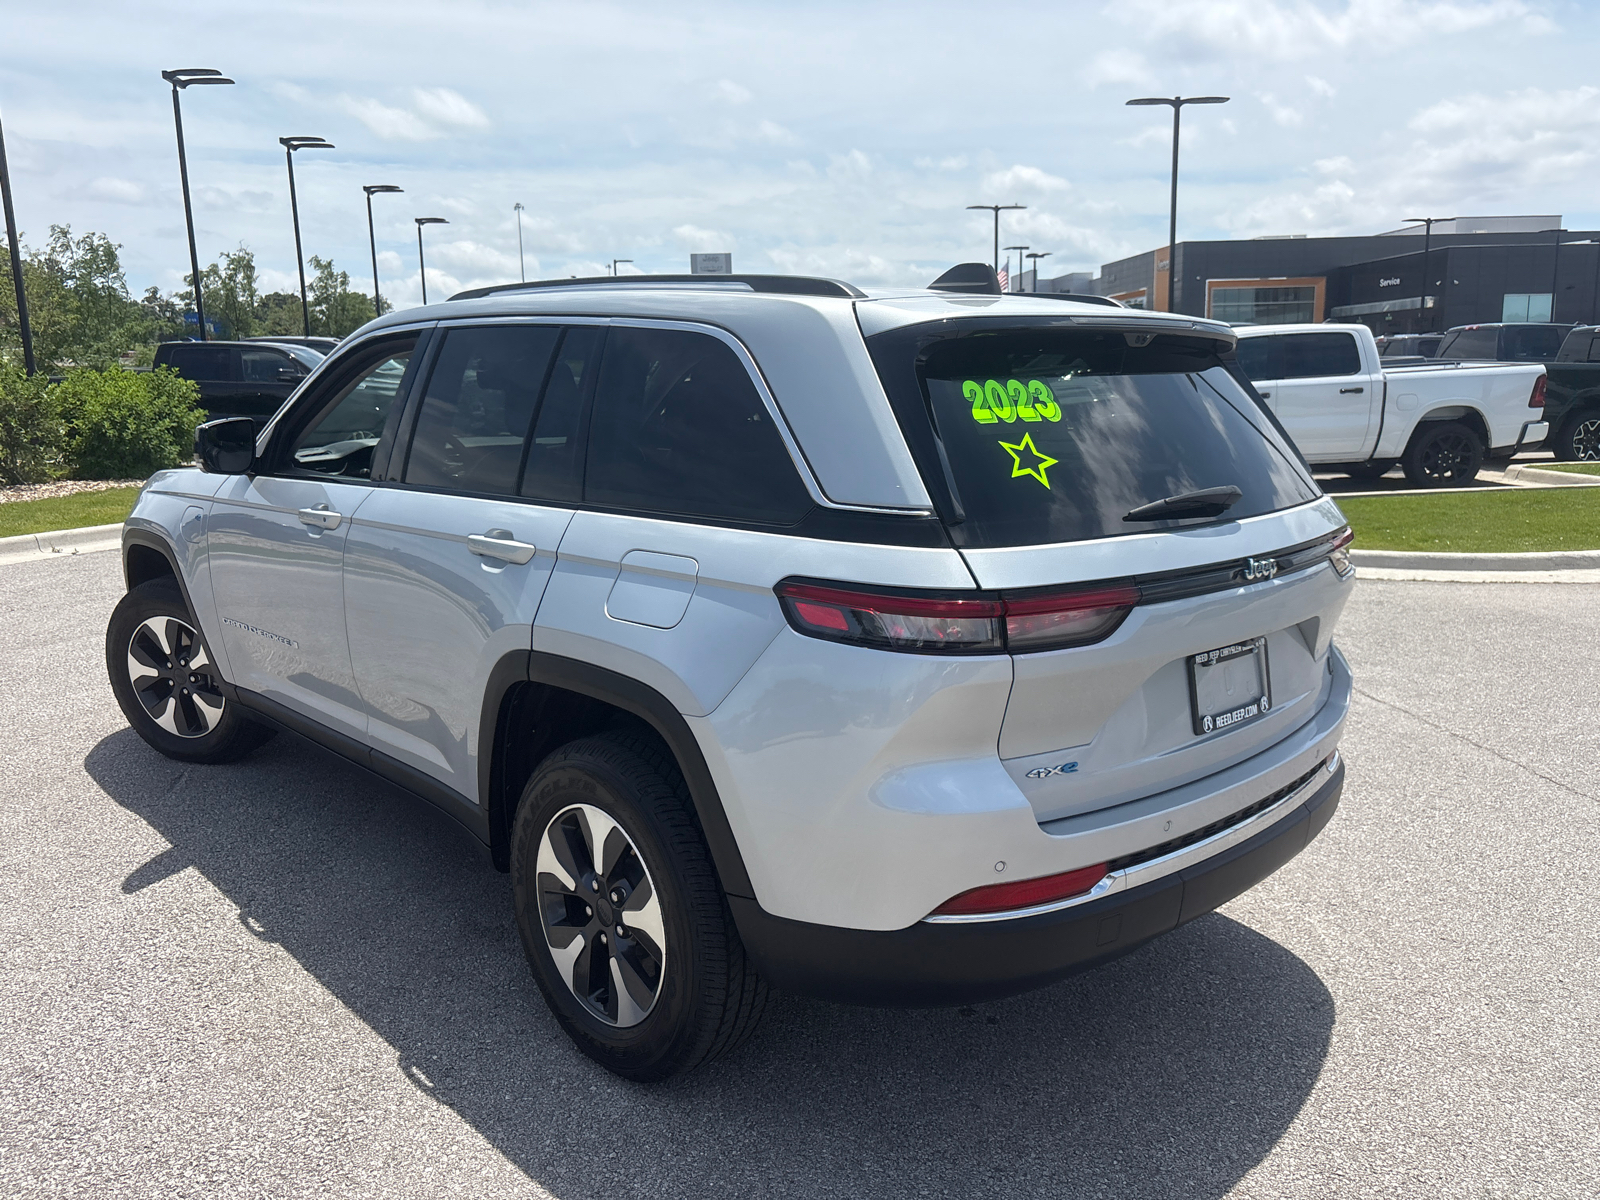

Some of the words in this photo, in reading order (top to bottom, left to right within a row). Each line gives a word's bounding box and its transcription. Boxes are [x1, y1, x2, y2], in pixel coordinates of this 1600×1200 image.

[1380, 277, 1400, 288] Service
[962, 379, 1062, 424] 2023
[1244, 558, 1278, 580] Jeep
[1195, 654, 1208, 664] REED
[1209, 650, 1220, 660] JEEP
[1216, 704, 1258, 728] REEDJEEP.COM
